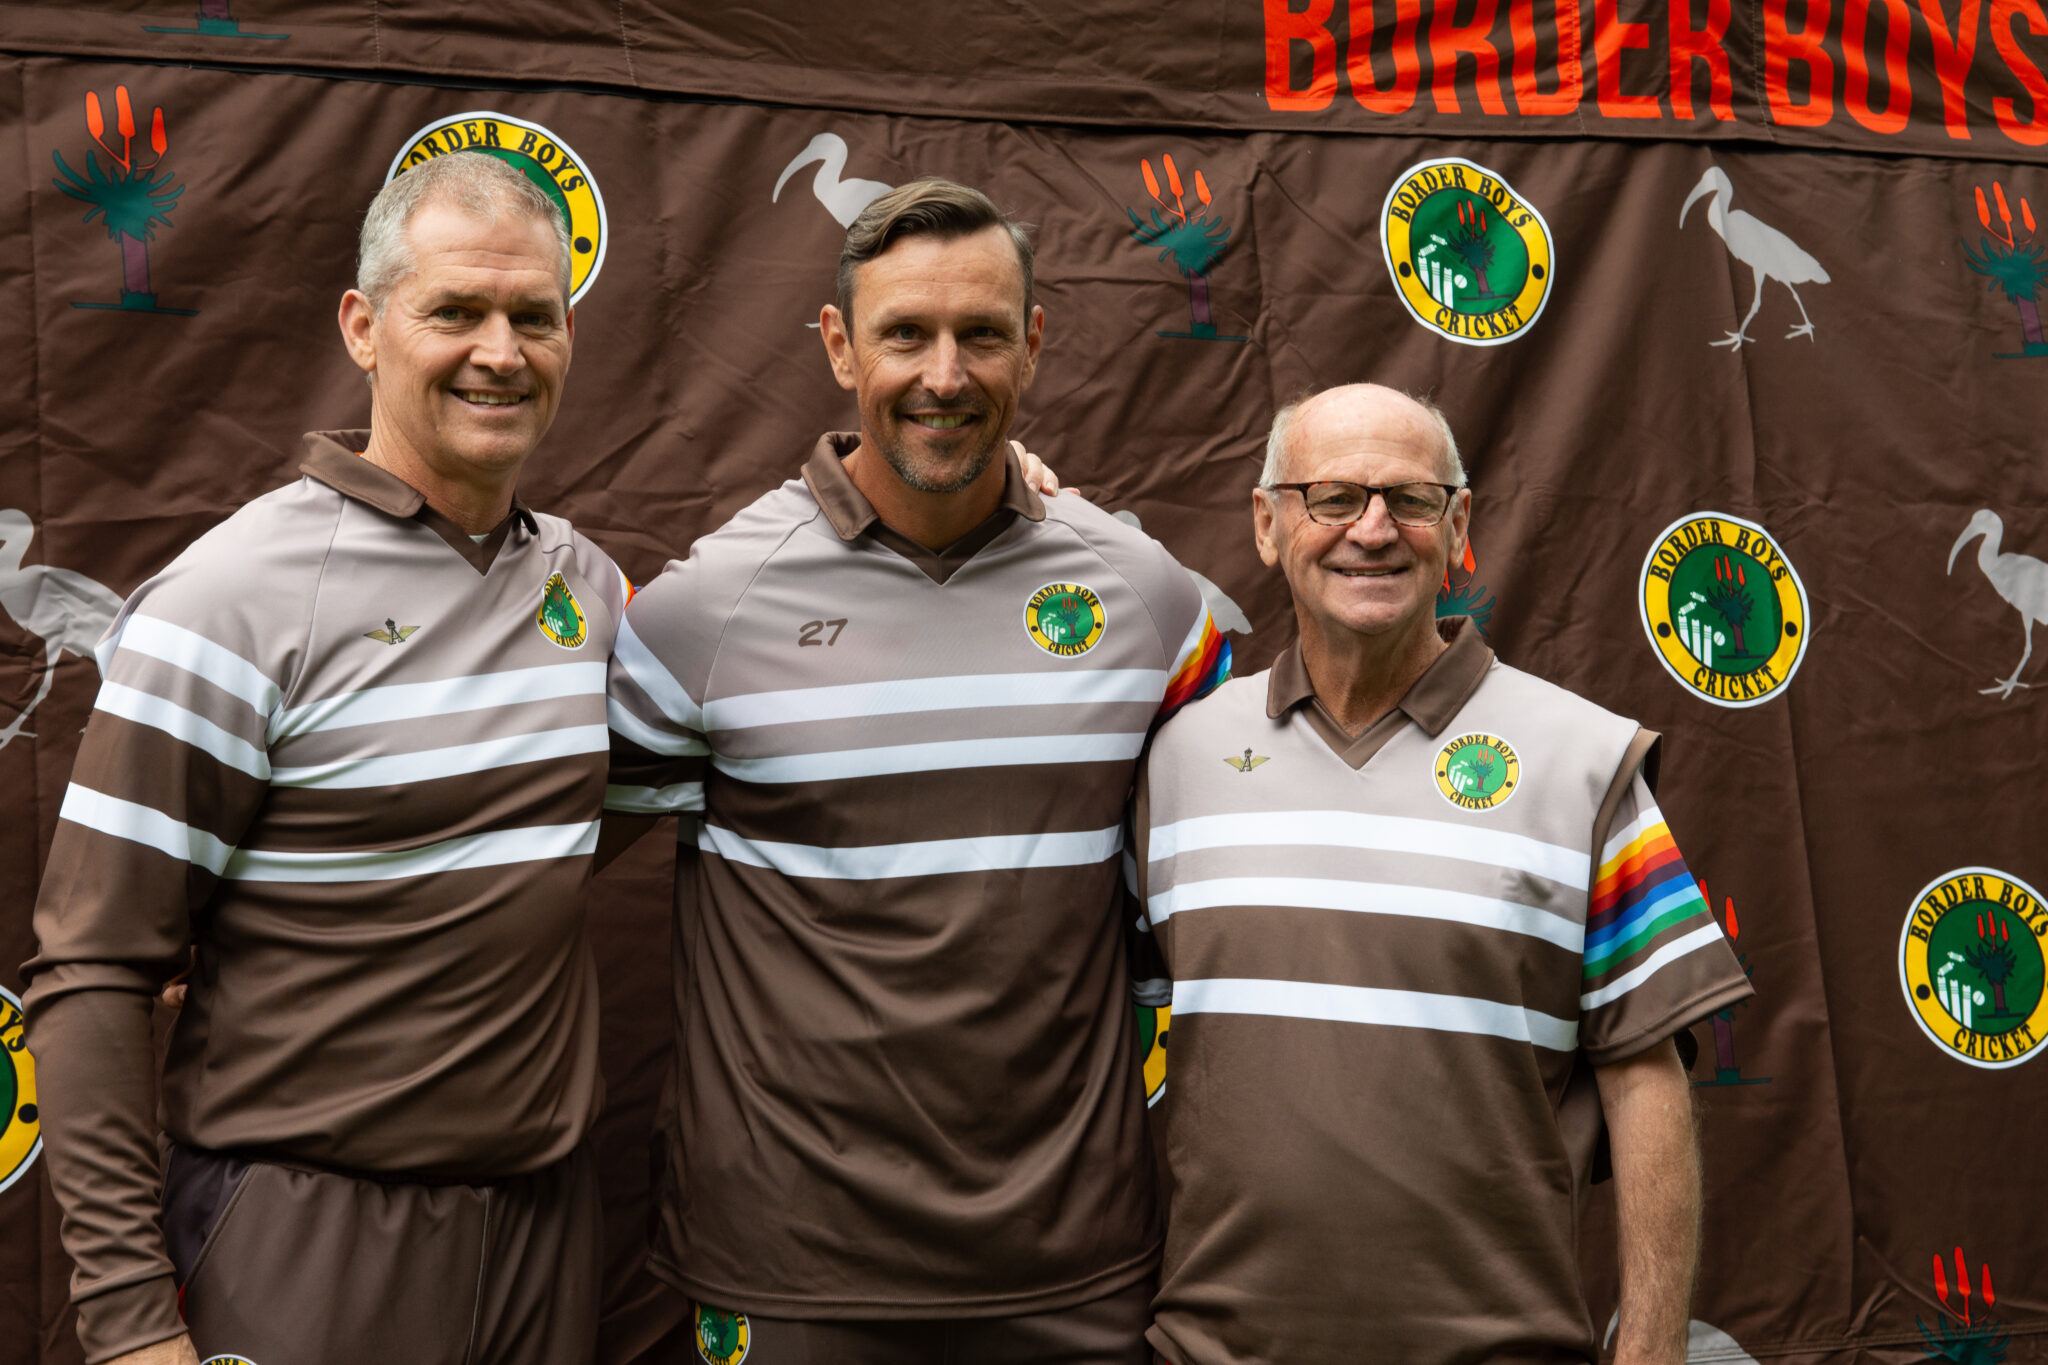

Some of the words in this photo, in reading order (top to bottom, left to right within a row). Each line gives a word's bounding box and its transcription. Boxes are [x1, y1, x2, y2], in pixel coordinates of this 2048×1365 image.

[1265, 0, 1737, 122] BORDER
[1764, 0, 2048, 146] BOYS
[518, 131, 585, 192] BOYS
[1391, 166, 1466, 224] BORDER
[1478, 176, 1532, 228] BOYS
[1435, 304, 1523, 337] CRICKET
[1650, 521, 1723, 583] BORDER
[1735, 528, 1787, 582] BOYS
[1028, 584, 1068, 610] BORDER
[1075, 585, 1099, 607] BOYS
[798, 618, 848, 647] 27
[1048, 640, 1089, 655] CRICKET
[1694, 665, 1779, 699] CRICKET
[1443, 735, 1489, 756] BORDER
[1494, 739, 1517, 764] BOYS
[1450, 791, 1494, 809] CRICKET
[1910, 876, 1986, 943] BORDER
[1998, 883, 2048, 937] BOYS
[1953, 1023, 2037, 1059] CRICKET
